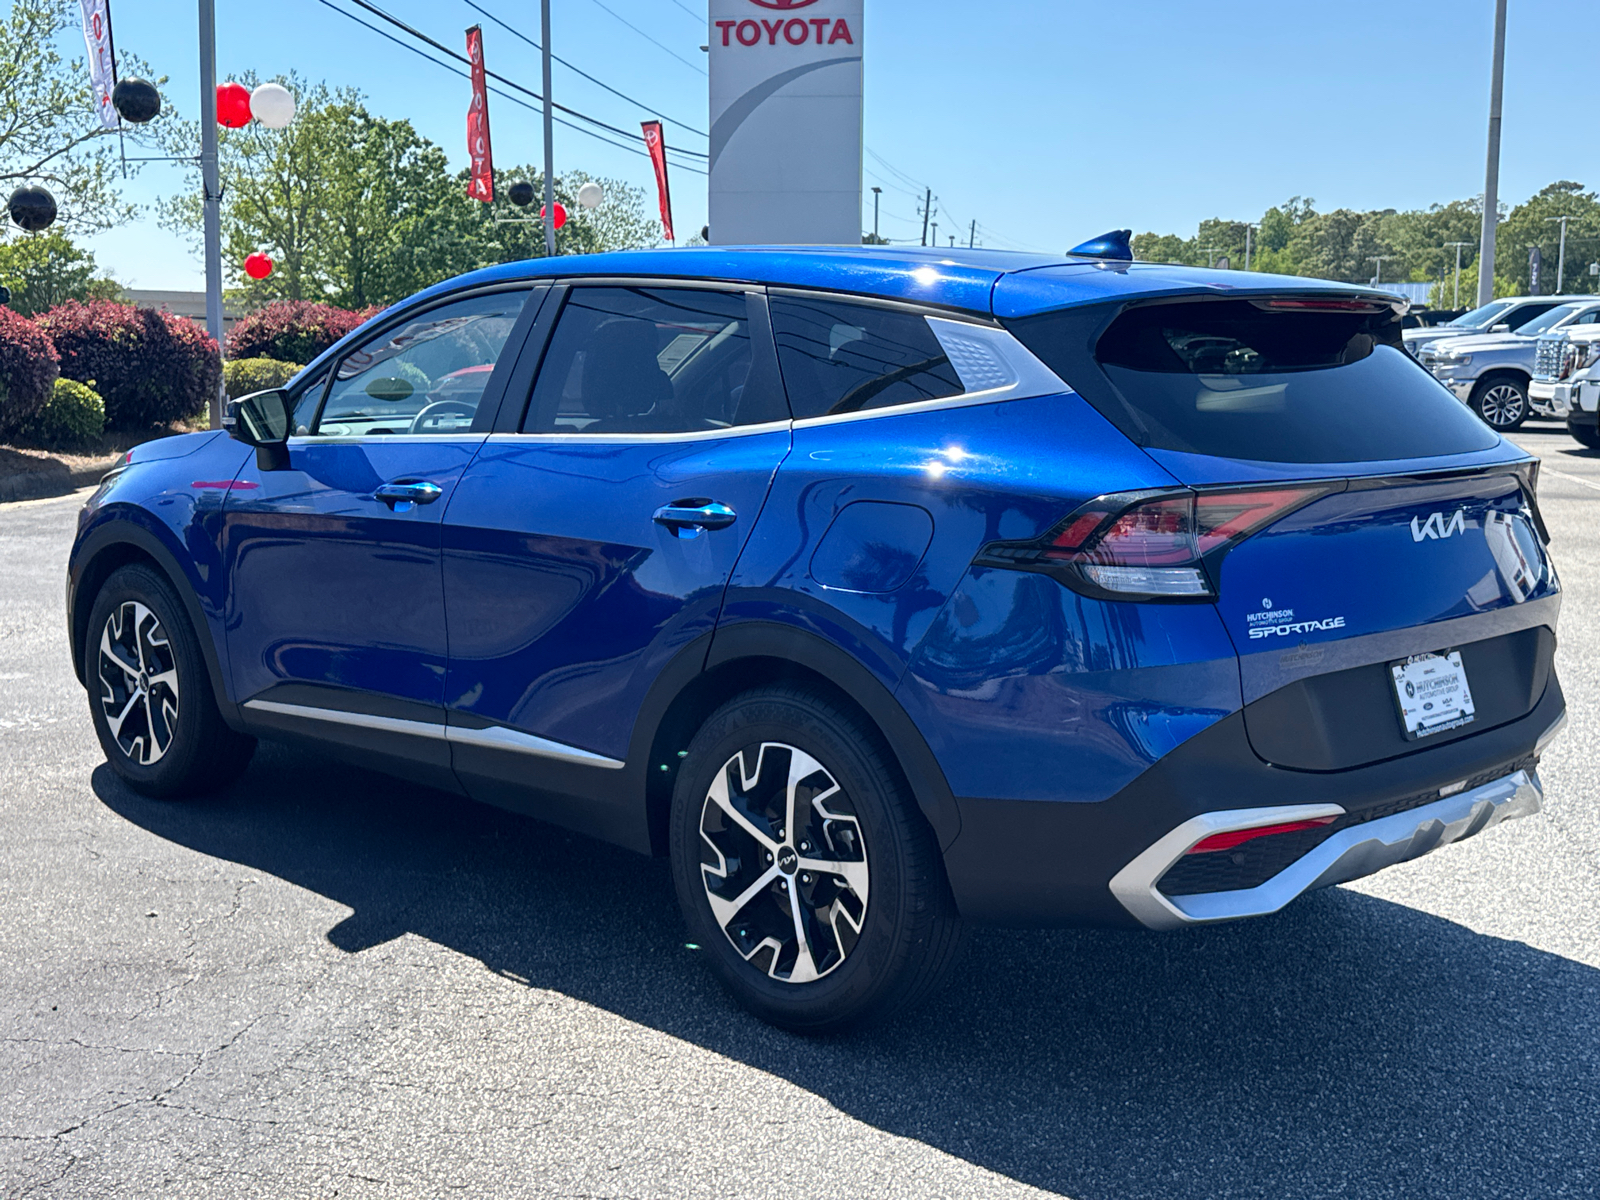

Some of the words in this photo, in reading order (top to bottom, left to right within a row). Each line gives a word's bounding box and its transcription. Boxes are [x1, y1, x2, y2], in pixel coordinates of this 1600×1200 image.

[715, 18, 854, 47] TOYOTA
[473, 67, 488, 196] OYOTA
[1246, 609, 1294, 622] HUTCHINSON
[1278, 617, 1293, 625] GROUP
[1248, 616, 1346, 639] SPORTAGE
[1416, 674, 1460, 694] HUTCHINSON
[1445, 684, 1459, 695] GROUP
